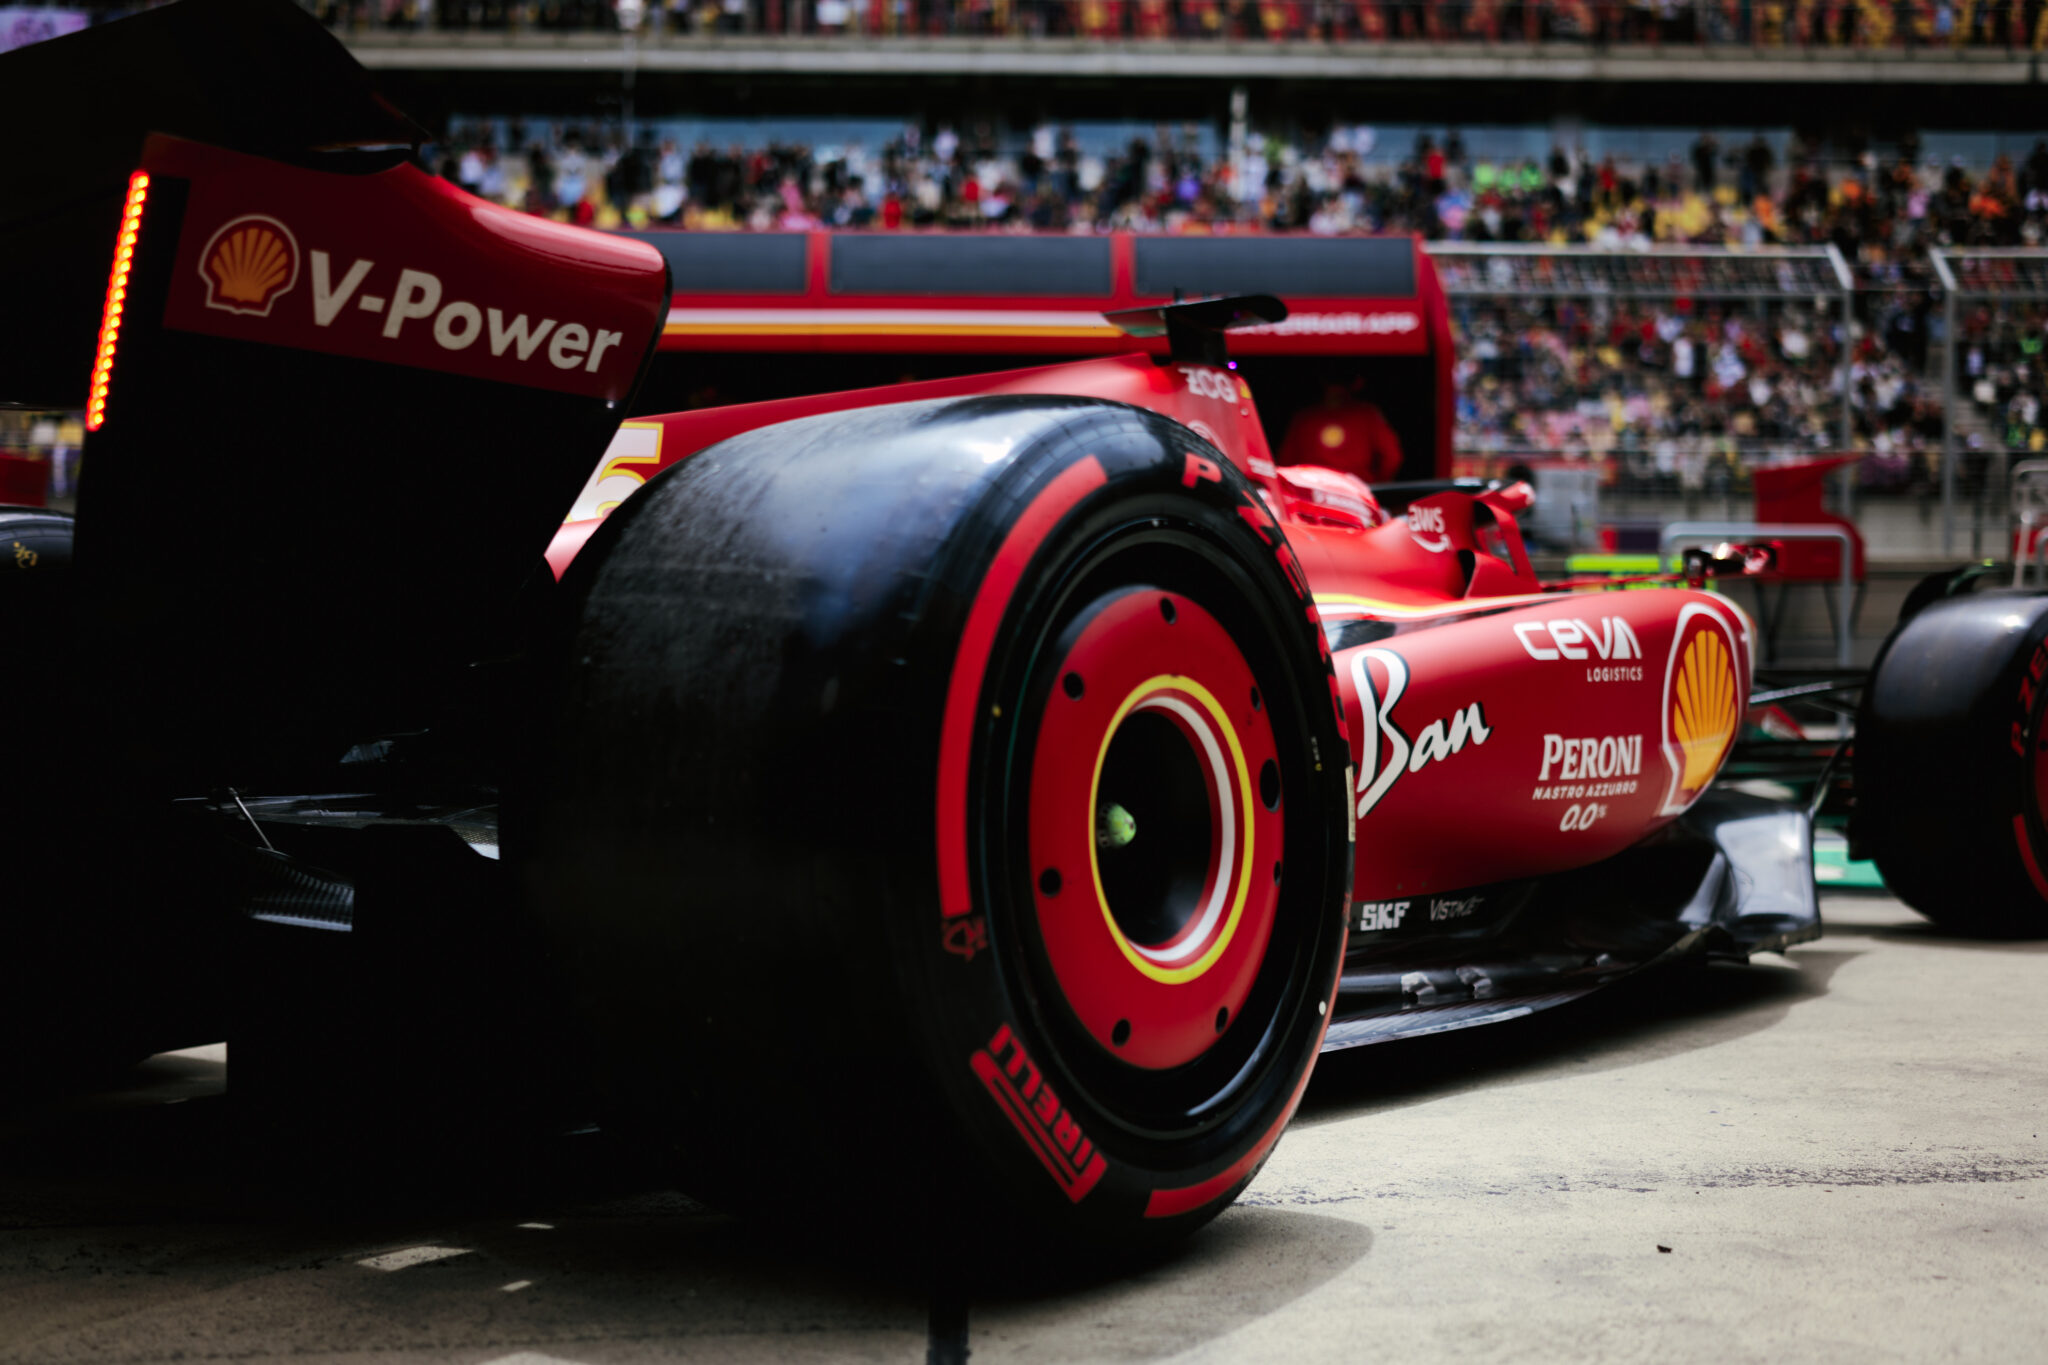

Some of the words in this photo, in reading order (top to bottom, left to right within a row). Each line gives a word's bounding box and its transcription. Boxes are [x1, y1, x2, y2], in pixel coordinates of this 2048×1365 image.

[310, 249, 624, 374] V-Power
[1181, 452, 1223, 489] P
[1408, 504, 1445, 534] aws
[1586, 666, 1643, 683] LOGISTICS
[1351, 648, 1493, 820] Ban
[1537, 733, 1643, 781] PERONI
[1532, 785, 1584, 801] NASTRO
[1586, 781, 1638, 798] AZZURRO
[1360, 901, 1411, 932] SKF
[970, 1022, 1108, 1203] PIRELLI
